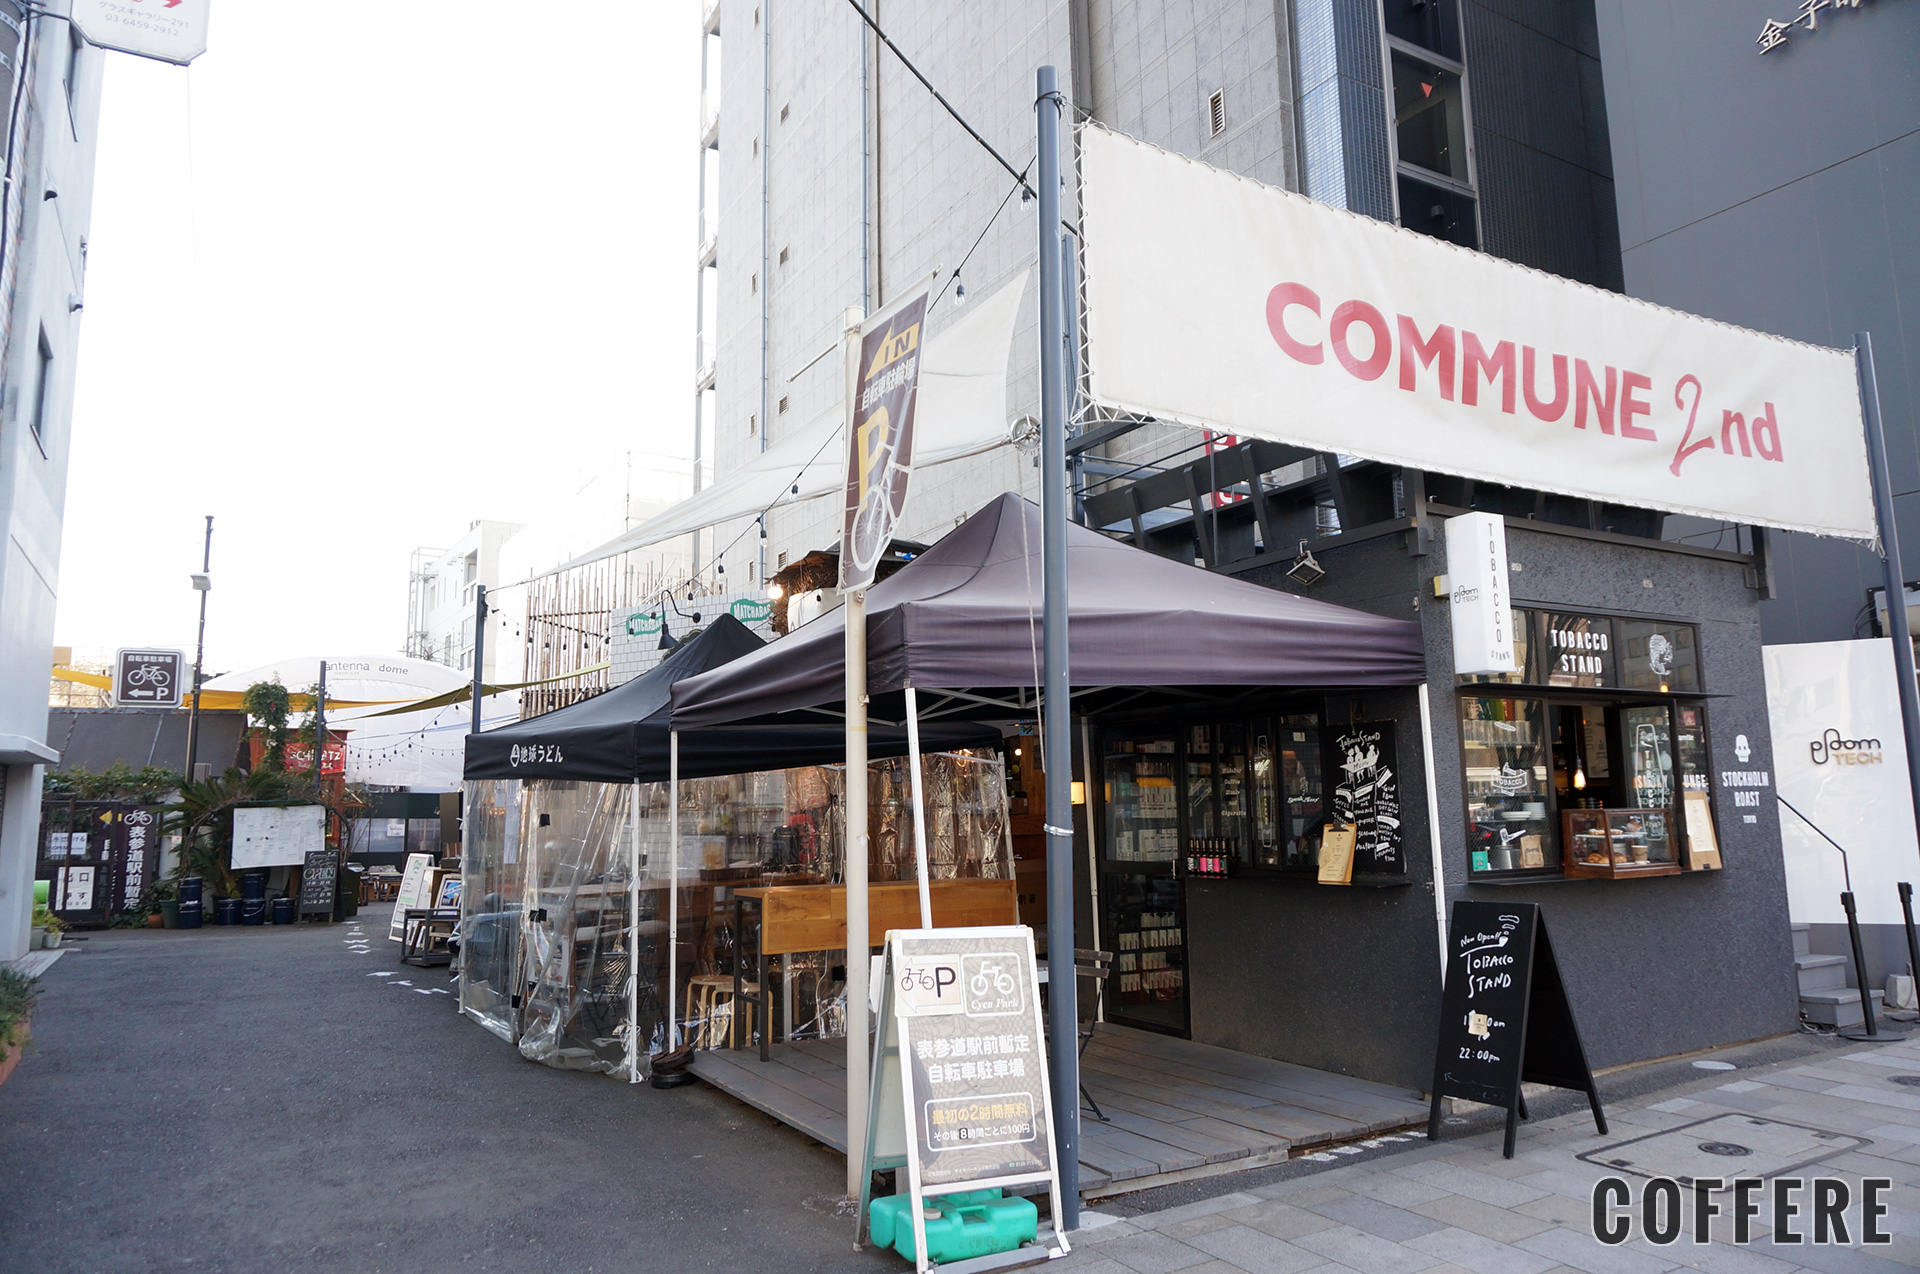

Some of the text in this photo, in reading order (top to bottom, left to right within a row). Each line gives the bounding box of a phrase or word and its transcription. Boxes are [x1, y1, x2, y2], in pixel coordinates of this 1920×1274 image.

[98, 1, 189, 28] グラスギャラリー291
[105, 13, 179, 36] 03-6459-2912
[884, 331, 911, 365] IN
[1266, 281, 1784, 477] COMMUNE 2nd
[857, 405, 889, 514] P
[1488, 523, 1502, 643] TOBACCO
[1462, 595, 1479, 603] TECH
[1551, 629, 1608, 651] TOBACCO
[1491, 650, 1511, 661] STAND
[1561, 654, 1602, 674] STAND
[325, 661, 409, 675] antenna dome
[156, 687, 169, 700] P
[520, 744, 563, 763] 地球うどん
[1811, 728, 1881, 765] ploom
[1833, 752, 1883, 765] TECH
[1496, 777, 1523, 787] TOBACCO
[1722, 771, 1769, 788] STOCKHOLM
[1734, 792, 1760, 806] ROAST
[123, 826, 146, 910] 表参道駅前暫定
[303, 868, 337, 880] OPEN
[1465, 953, 1514, 975] TOBACCO
[935, 966, 956, 998] P
[1467, 972, 1512, 998] STAND
[996, 998, 1018, 1009] Park
[917, 1034, 1030, 1060] 表参道駅前暫定
[1459, 1047, 1501, 1063] 22:00pm
[928, 1058, 1025, 1083] 自転車駐車場
[932, 1102, 1028, 1125] 最初の2時間無料
[933, 1123, 1030, 1142] その後8時間ごとに100円
